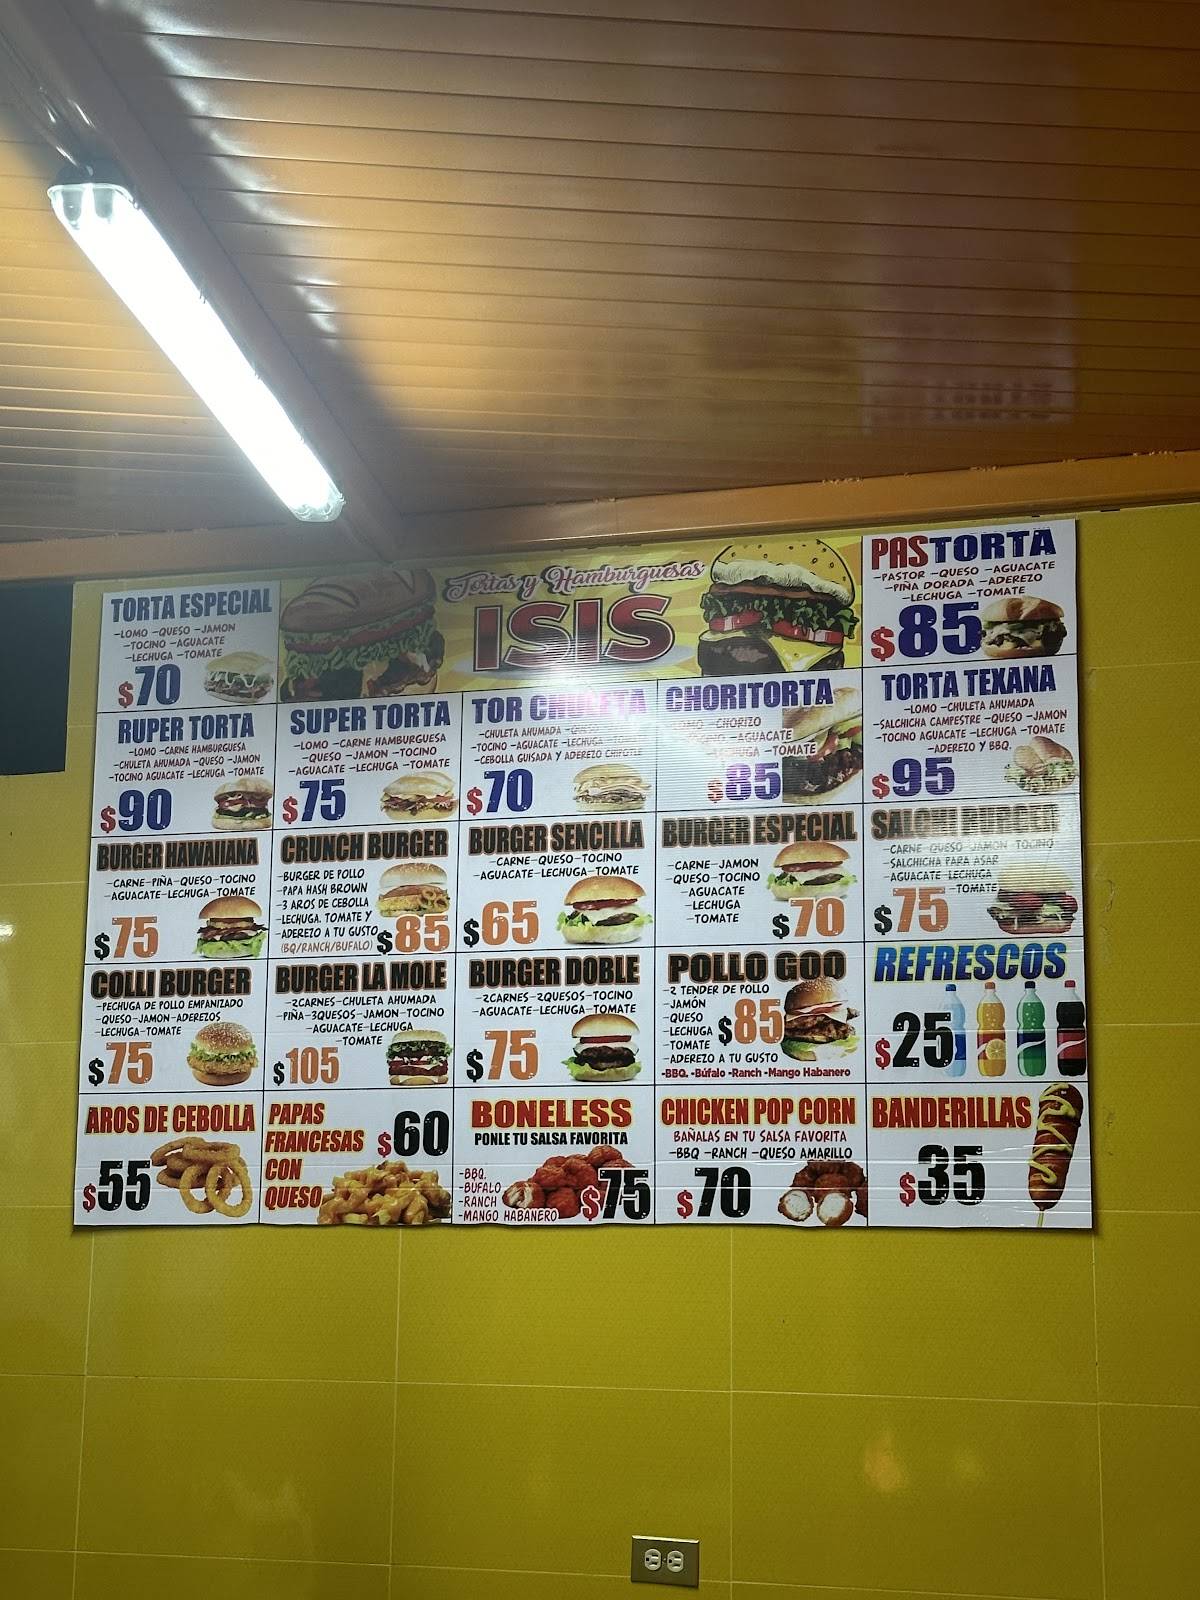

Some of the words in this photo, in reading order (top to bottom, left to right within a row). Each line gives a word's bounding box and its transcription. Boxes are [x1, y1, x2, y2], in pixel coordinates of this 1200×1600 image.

[872, 527, 1056, 570] PASTORTA
[545, 561, 704, 593] Hamburguesas
[924, 579, 974, 589] DORADA
[111, 595, 175, 622] TORTA
[180, 589, 272, 617] ESPECIAL
[473, 594, 675, 672] ISIS
[881, 671, 960, 701] TORTA
[964, 664, 1056, 697] TEXANA
[666, 678, 834, 712] CHORITORTA
[989, 698, 1034, 709] AHUMADA
[290, 707, 366, 735] SUPER
[373, 701, 450, 729] TORTA
[472, 696, 522, 723] TOR
[930, 714, 980, 726] CAMPESTRE
[118, 717, 184, 744] RUPER
[189, 713, 254, 740] TORTA
[375, 733, 446, 745] HAMBURGUESA
[521, 726, 561, 737] AHUMADA
[518, 752, 551, 762] GUISADA
[556, 751, 562, 761] Y
[565, 750, 602, 760] ADEREZO
[979, 742, 985, 752] Y
[989, 741, 1012, 751] BBQ.
[154, 758, 191, 767] AHUMADA
[469, 823, 548, 856] BURGER
[550, 819, 645, 852] SENCILLA
[662, 816, 751, 848] BURGER
[753, 811, 858, 845] ESPECIAL
[96, 841, 164, 871] BURGER
[164, 837, 259, 869] HAWAIIANA
[280, 832, 365, 864] CRUNCH
[367, 828, 449, 860] BURGER
[323, 869, 334, 879] DE
[338, 869, 365, 879] POLLO
[306, 884, 327, 895] HASH
[330, 883, 368, 894] BROWN
[291, 900, 315, 910] AROS
[318, 899, 329, 909] DE
[332, 897, 369, 908] CEBOLLA
[324, 928, 330, 937] A
[333, 927, 344, 937] TU
[349, 925, 378, 936] GUSTO
[469, 957, 561, 989] BURGER
[565, 955, 640, 986] DOBLE
[668, 951, 769, 984] POLLO
[775, 949, 847, 982] GOO
[874, 942, 1067, 982] REFRESCOS
[91, 969, 156, 1000] COLLI
[159, 967, 252, 998] BURGER
[275, 963, 359, 994] BURGER
[362, 962, 388, 991] LA
[390, 960, 448, 991] MOLE
[680, 985, 719, 995] TENDER
[722, 985, 736, 994] DE
[740, 984, 769, 993] POLLO
[144, 1001, 156, 1010] DE
[159, 1000, 185, 1010] POLLO
[188, 999, 244, 1009] EMPANIZADO
[803, 1067, 850, 1077] Habanero
[85, 1106, 139, 1134] AROS
[144, 1106, 168, 1133] DE
[173, 1104, 255, 1132] CEBOLLA
[268, 1103, 325, 1125] PAPAS
[472, 1099, 632, 1128] BONELESS
[661, 1098, 749, 1125] CHICKEN
[754, 1098, 794, 1125] POP
[799, 1097, 856, 1125] CORN
[873, 1097, 1031, 1128] BANDERILLAS
[265, 1129, 364, 1152] FRANCESAS
[475, 1133, 510, 1145] PONLE
[513, 1133, 528, 1145] TU
[531, 1132, 567, 1145] SALSA
[571, 1131, 628, 1145] FAVORITA
[673, 1128, 720, 1143] BAÑALAS
[725, 1131, 738, 1141] EN
[743, 1131, 755, 1142] TU
[759, 1130, 790, 1142] SALSA
[795, 1130, 847, 1142] FAVORITA
[800, 1147, 852, 1158] AMARILLO
[265, 1158, 302, 1180] CON
[265, 1186, 322, 1210] QUESO
[504, 1210, 558, 1221] HABANERO
